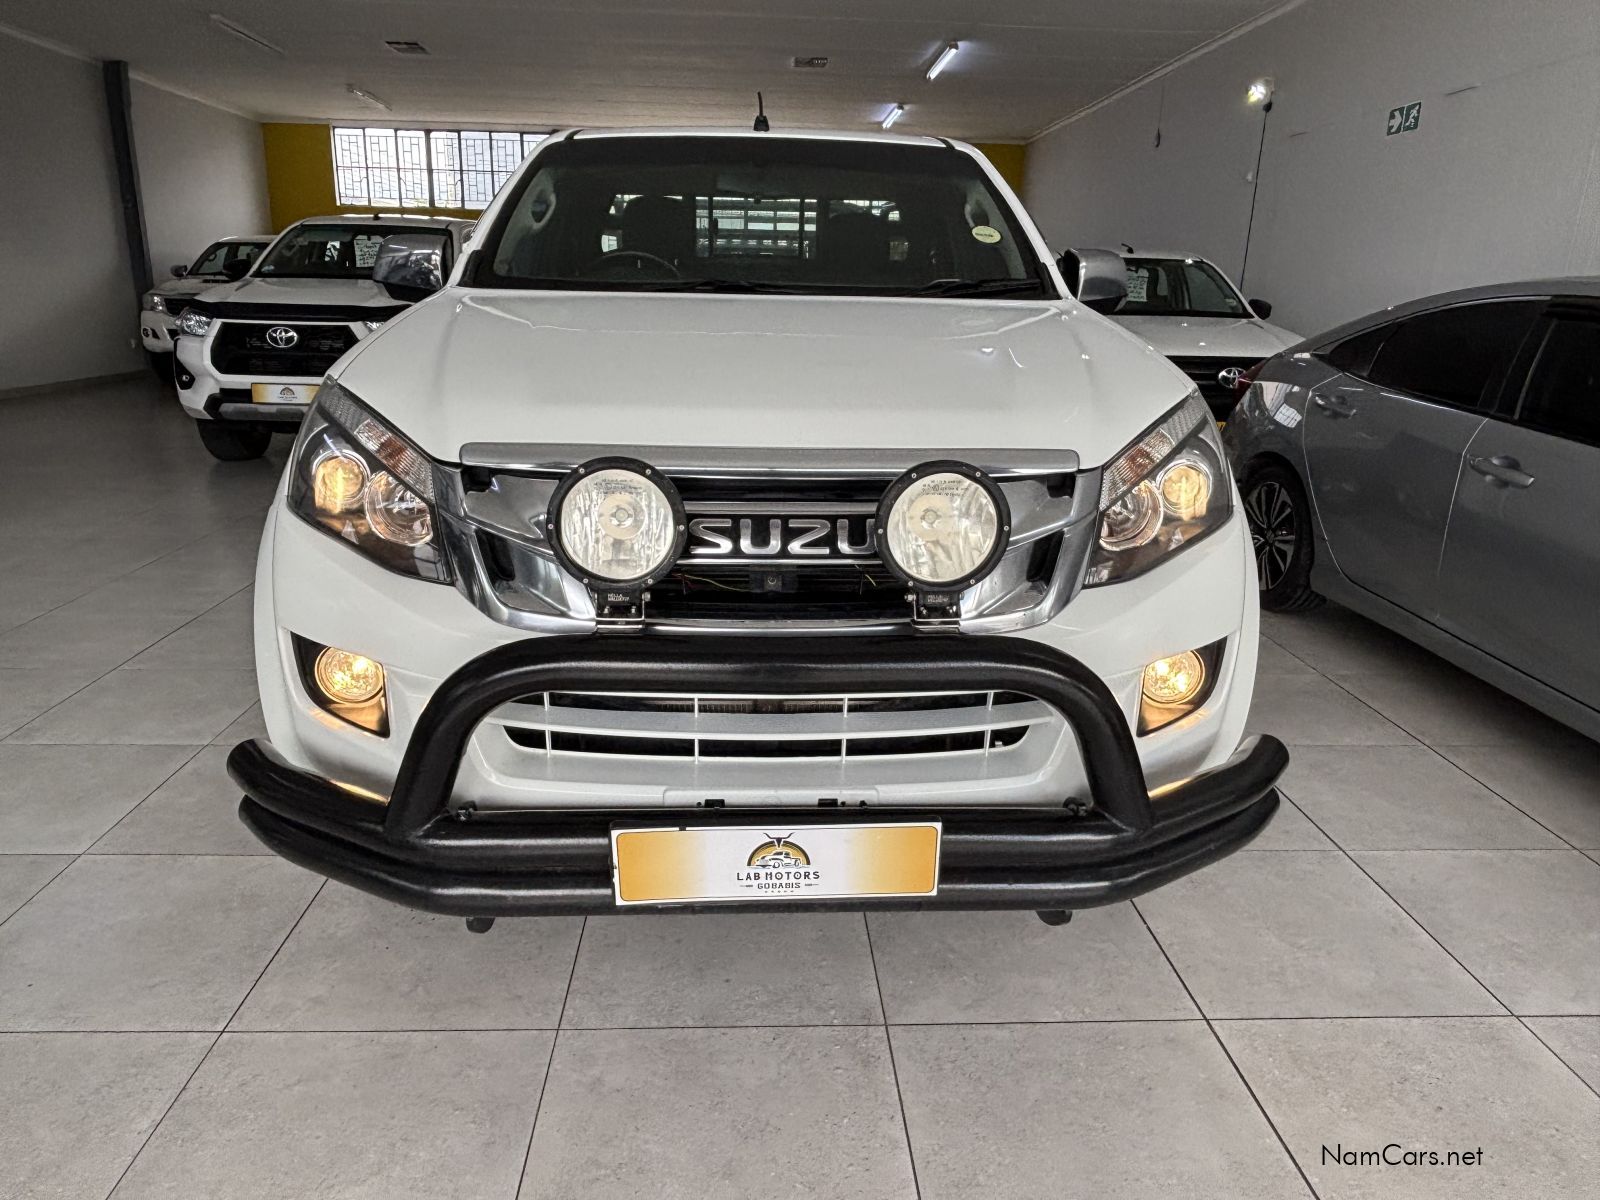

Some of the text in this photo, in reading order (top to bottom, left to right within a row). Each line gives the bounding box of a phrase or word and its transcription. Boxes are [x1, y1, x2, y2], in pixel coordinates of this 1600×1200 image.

[736, 871, 820, 881] LAB MOTORS
[757, 882, 801, 890] GOBABIS
